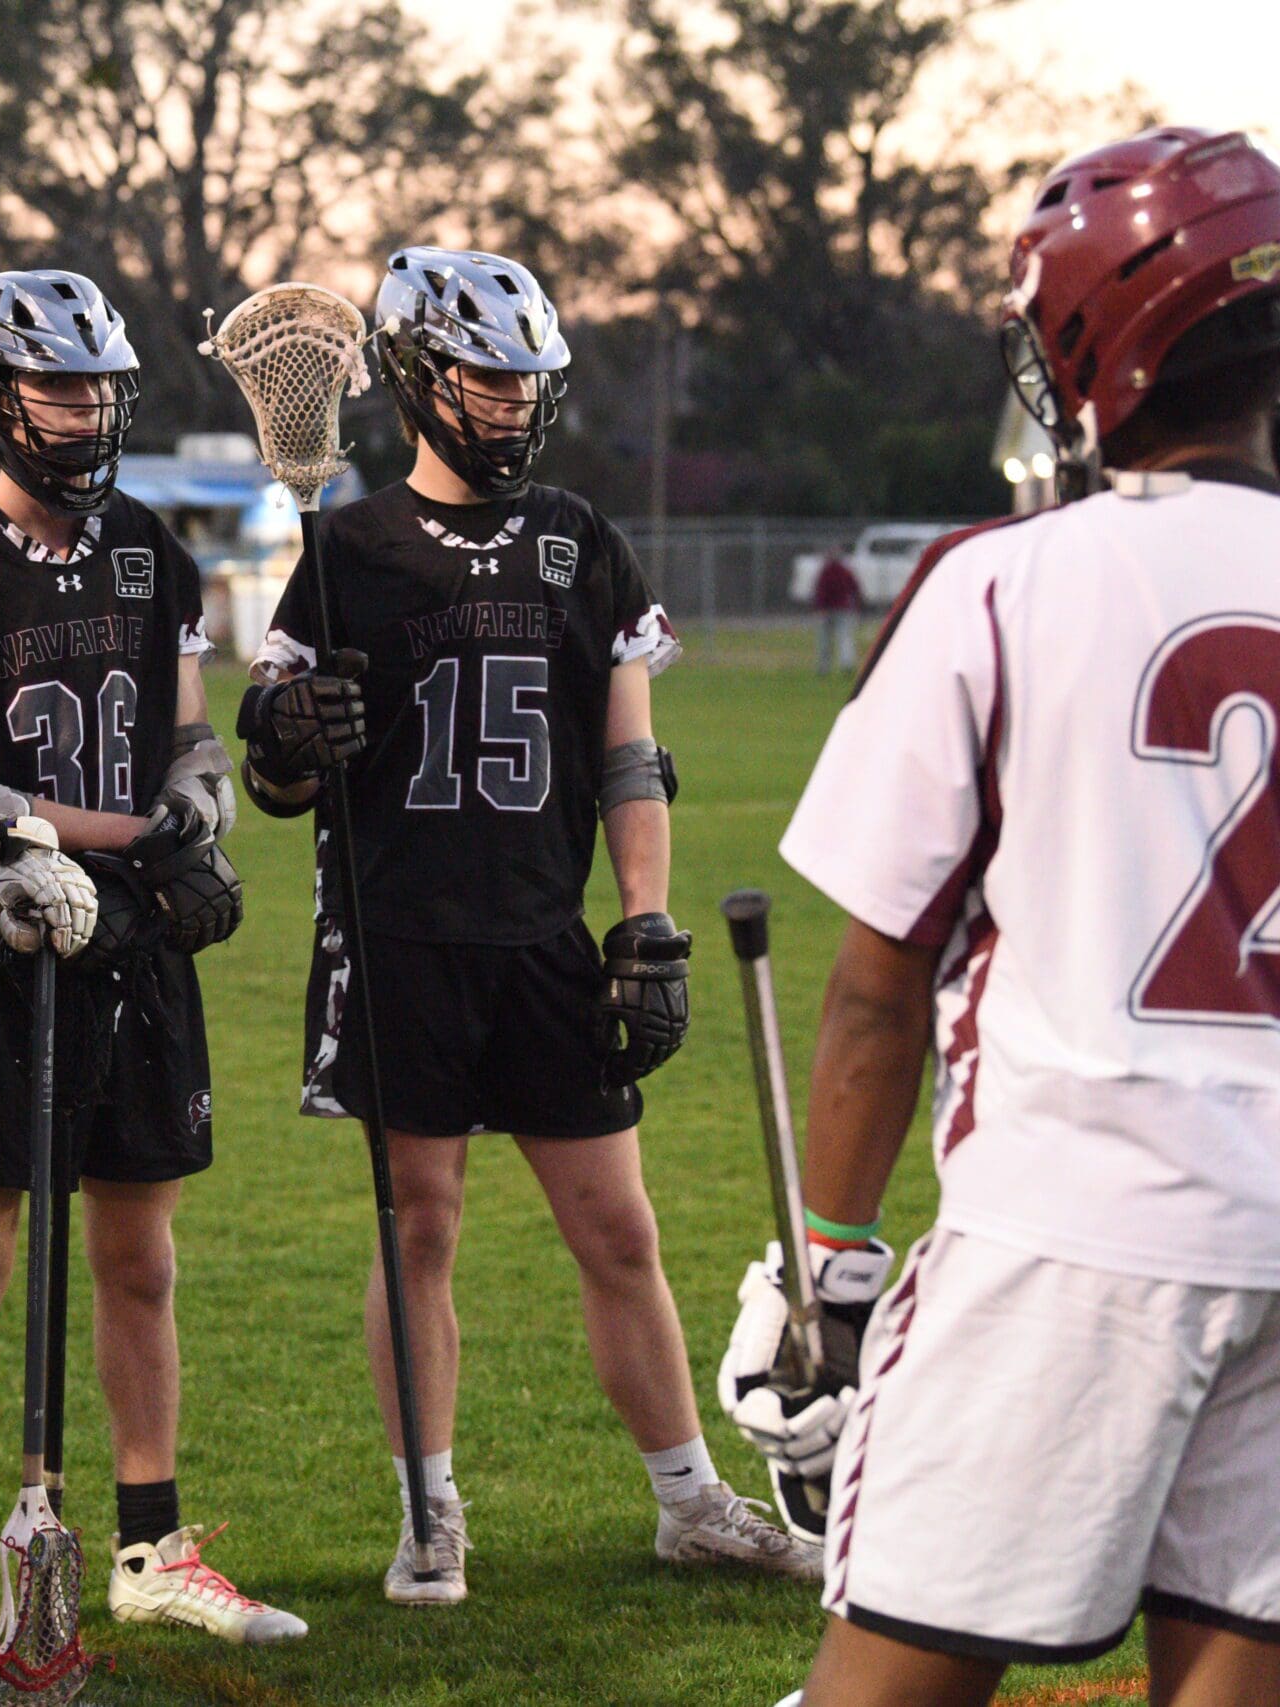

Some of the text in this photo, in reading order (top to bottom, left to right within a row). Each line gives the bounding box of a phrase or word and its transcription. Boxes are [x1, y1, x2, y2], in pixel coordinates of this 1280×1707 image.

[112, 549, 153, 587] C
[540, 536, 578, 576] C
[6, 670, 138, 816] 36
[404, 655, 551, 812] 15
[1128, 612, 1280, 1029] 2
